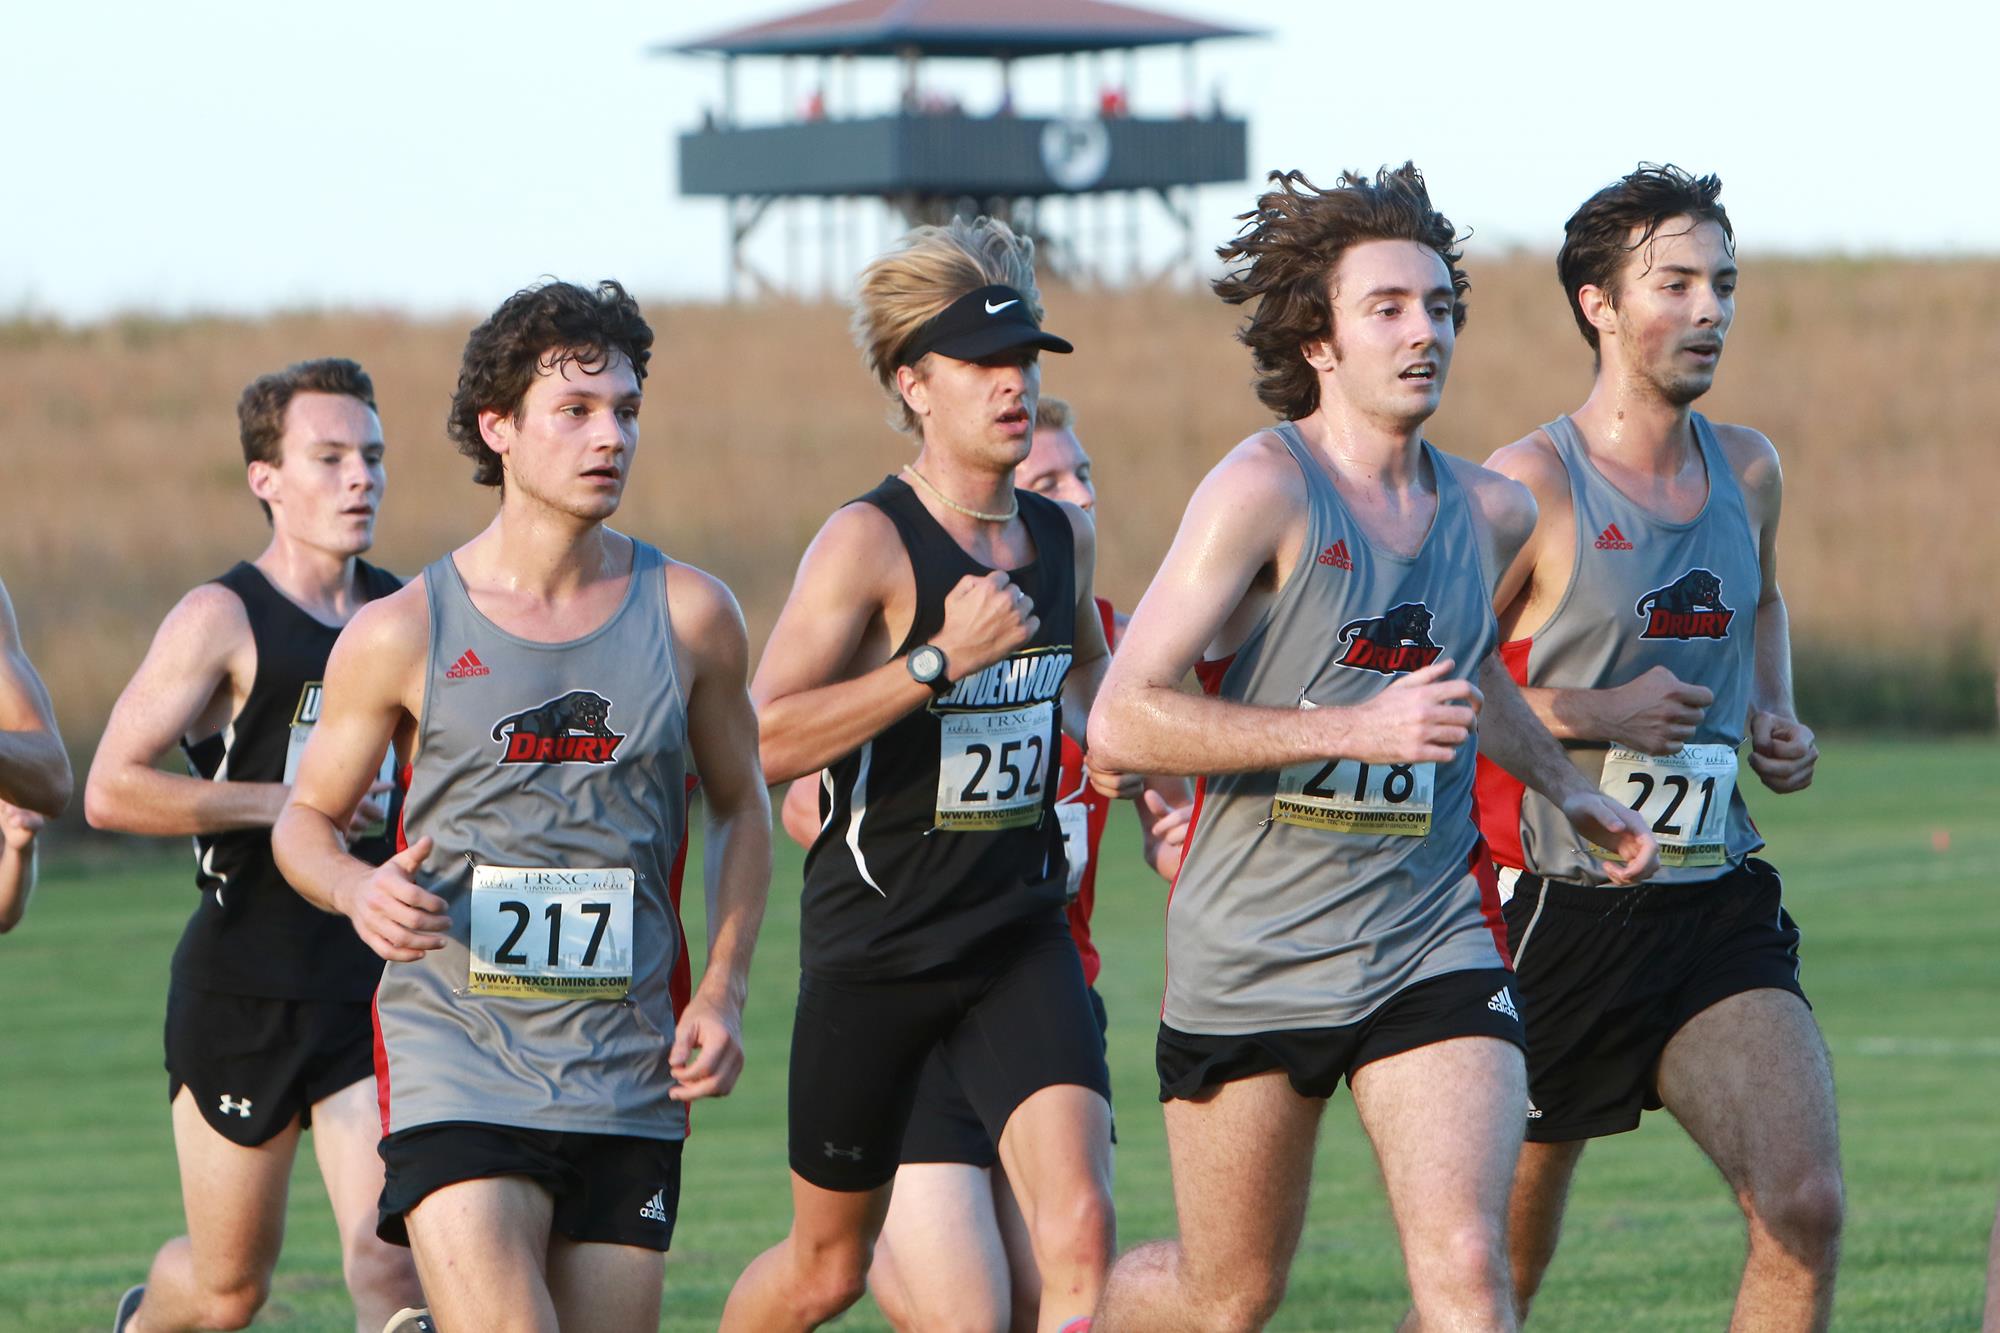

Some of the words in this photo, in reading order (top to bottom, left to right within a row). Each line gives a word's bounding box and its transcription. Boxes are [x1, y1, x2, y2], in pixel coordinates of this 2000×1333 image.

[1594, 540, 1633, 550] adidas
[1318, 554, 1354, 571] adidas
[446, 665, 490, 679] adidas
[960, 735, 1043, 802] 252
[1303, 758, 1414, 804] 218
[1279, 800, 1427, 823] WWW.TRXCTIMING.COM
[1627, 772, 1716, 836] 221
[518, 872, 590, 886] TRXC
[494, 900, 612, 967] 217
[474, 972, 628, 987] WWW.TRXCTIMING.COM
